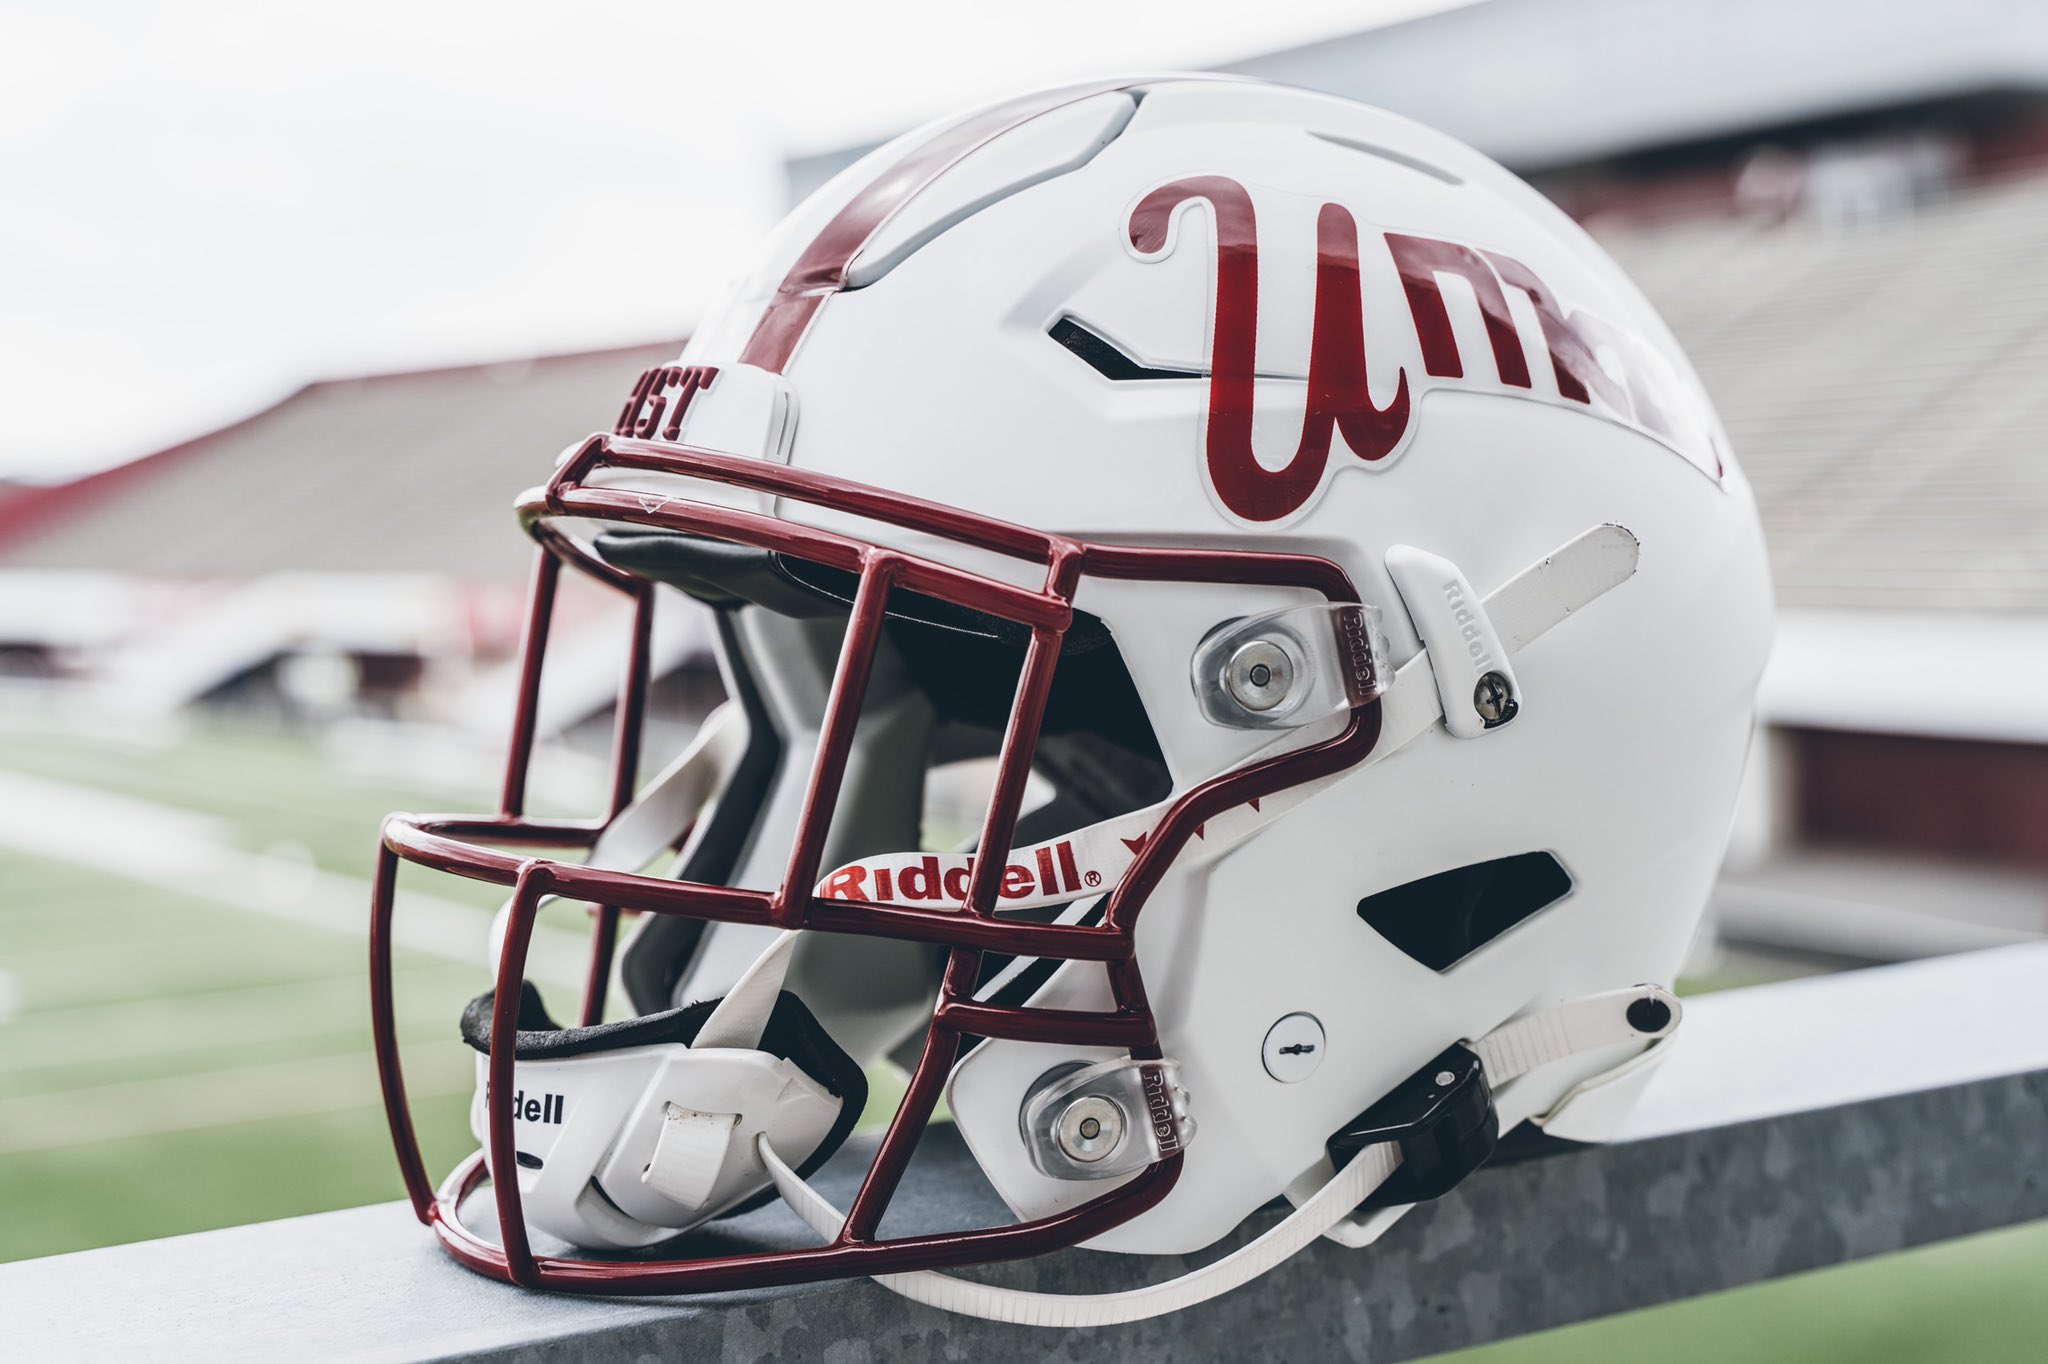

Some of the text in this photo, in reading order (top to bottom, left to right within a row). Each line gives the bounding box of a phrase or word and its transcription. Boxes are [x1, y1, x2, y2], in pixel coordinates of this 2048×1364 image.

[1344, 609, 1377, 696] Riddell
[1441, 578, 1494, 674] Riddell
[485, 1081, 564, 1125] dell
[1143, 1069, 1179, 1152] Riddell
